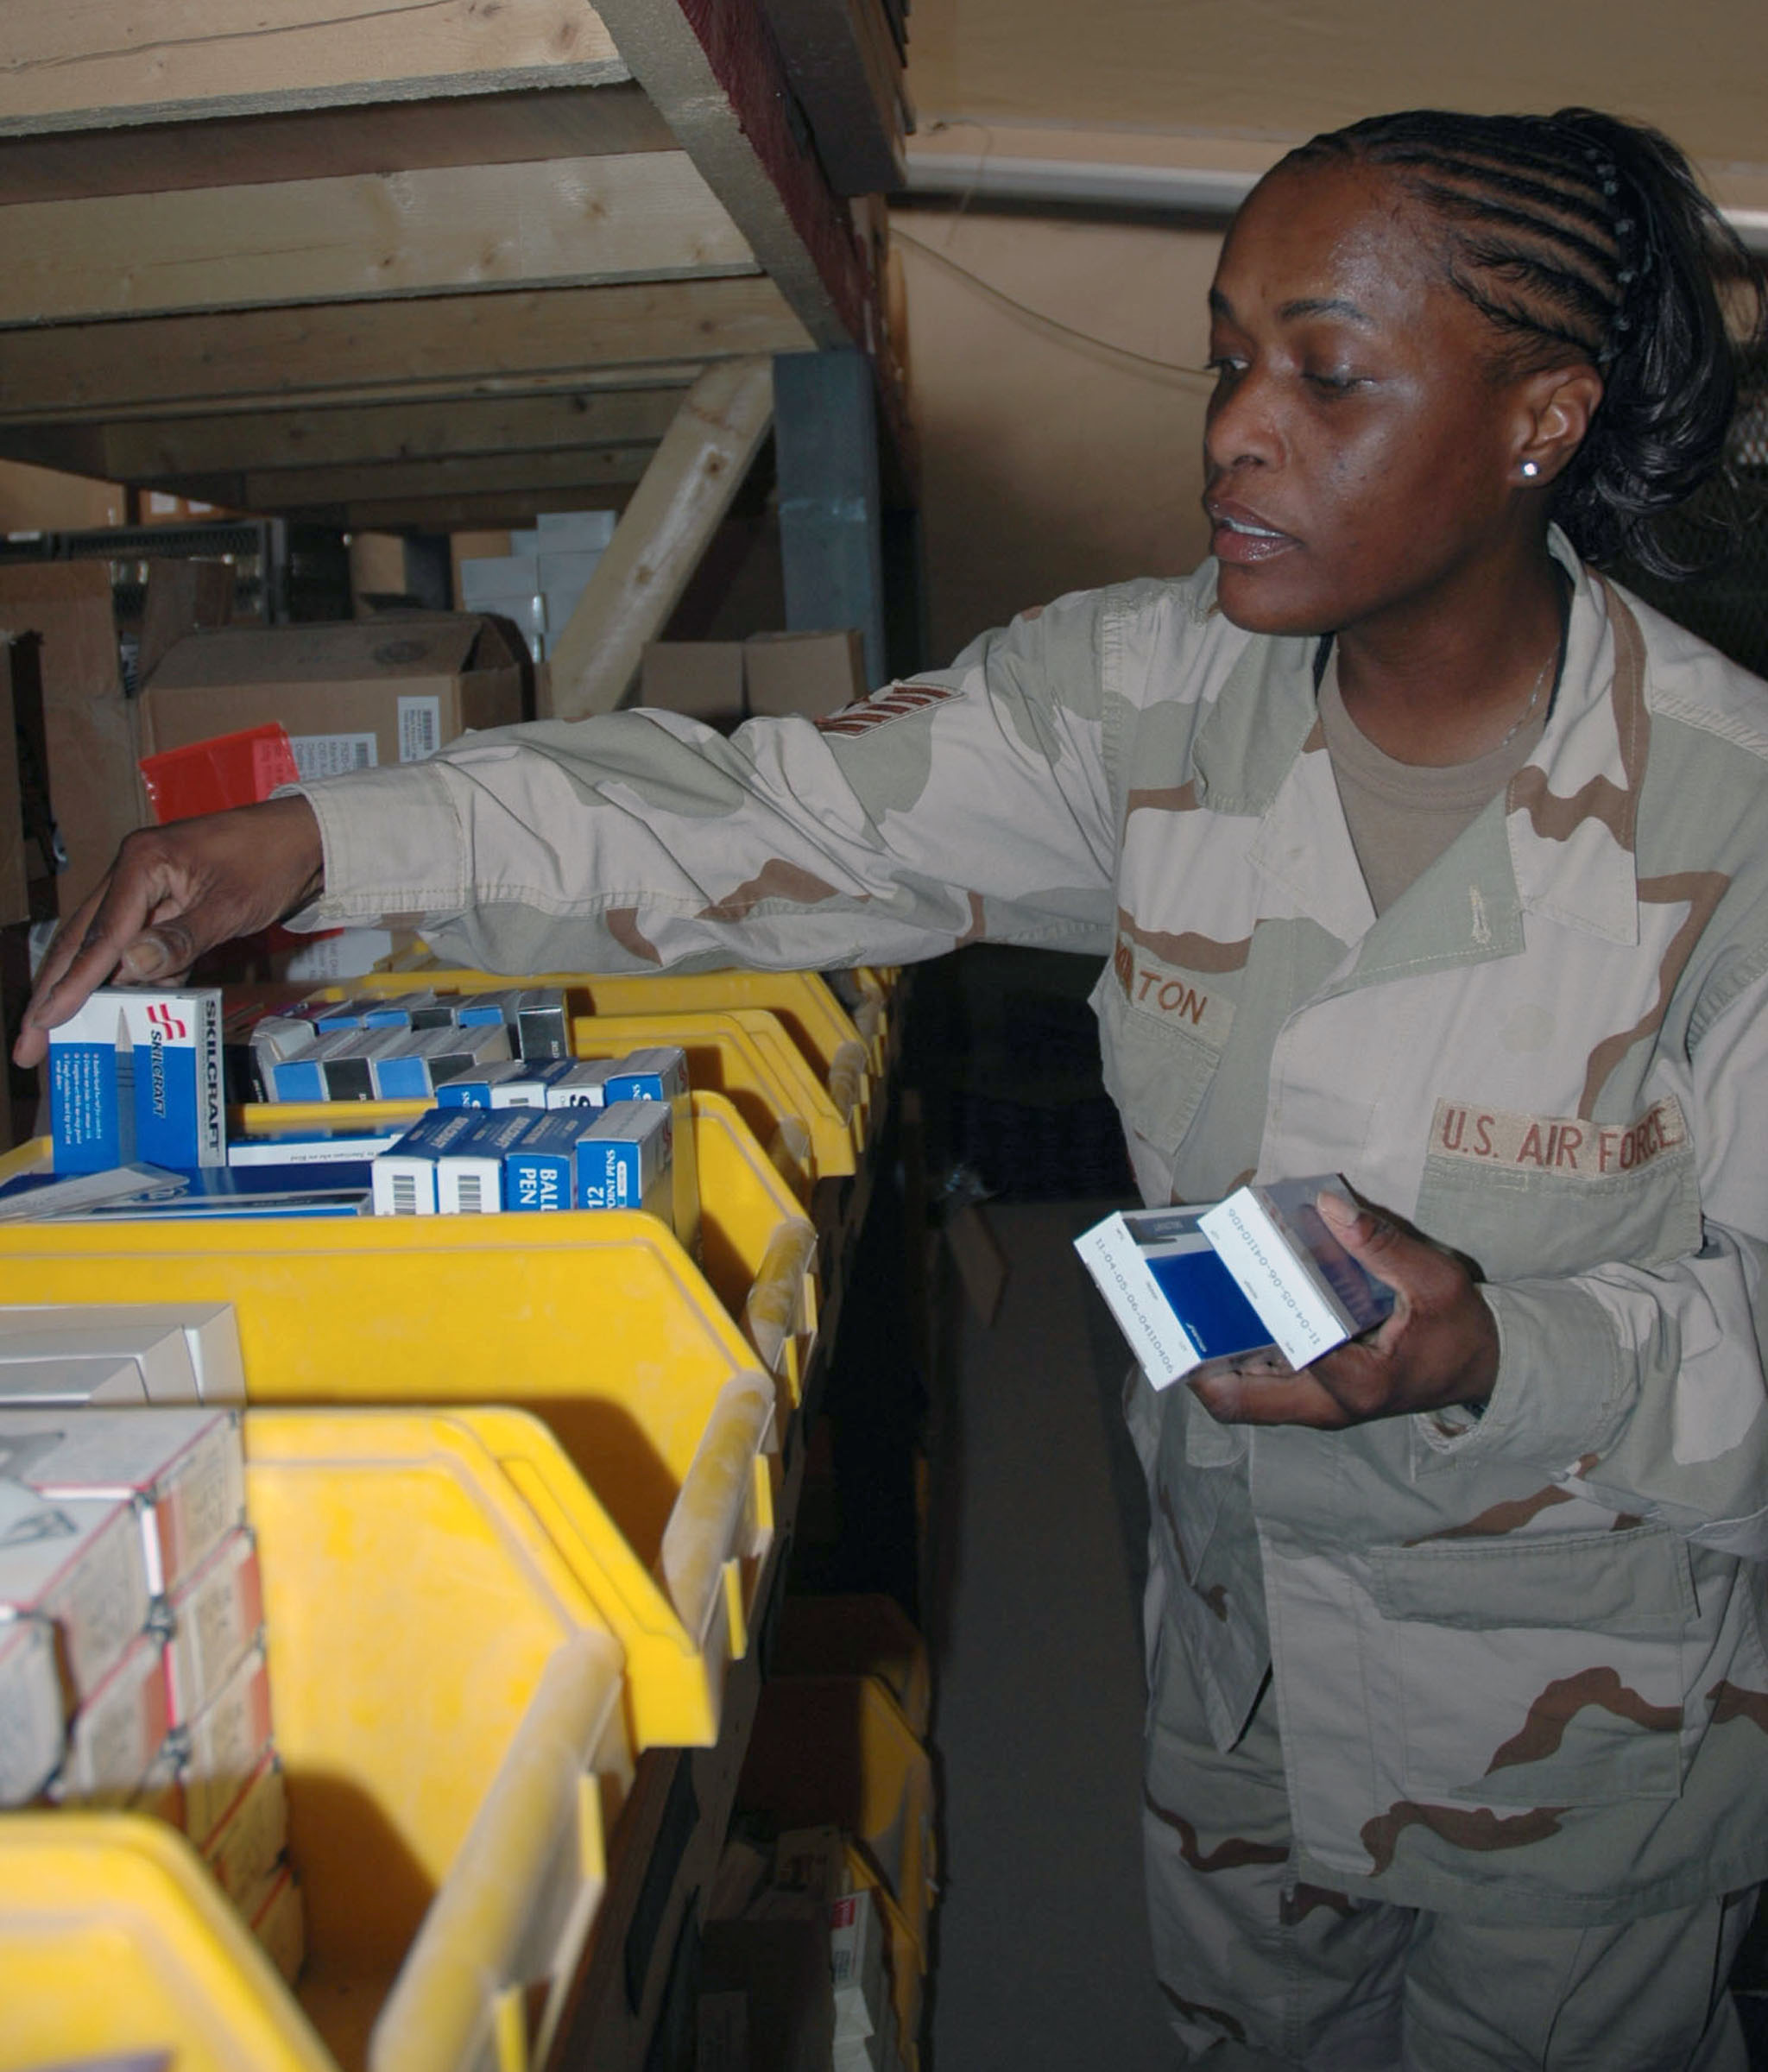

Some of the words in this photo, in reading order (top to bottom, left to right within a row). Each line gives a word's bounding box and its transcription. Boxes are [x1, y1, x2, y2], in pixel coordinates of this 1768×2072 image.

[1122, 950, 1208, 1026] TON
[150, 1028, 165, 1119] SKILCRAFT
[205, 1000, 219, 1150] SKILCRAFT
[1441, 1109, 1500, 1159] U.S.
[1516, 1123, 1583, 1170] AIR
[1598, 1107, 1684, 1173] FORCE
[606, 1149, 616, 1177] PENS
[519, 1167, 537, 1204] PEN
[540, 1168, 559, 1211] BALL
[587, 1186, 604, 1208] 12
[606, 1178, 616, 1210] OINT
